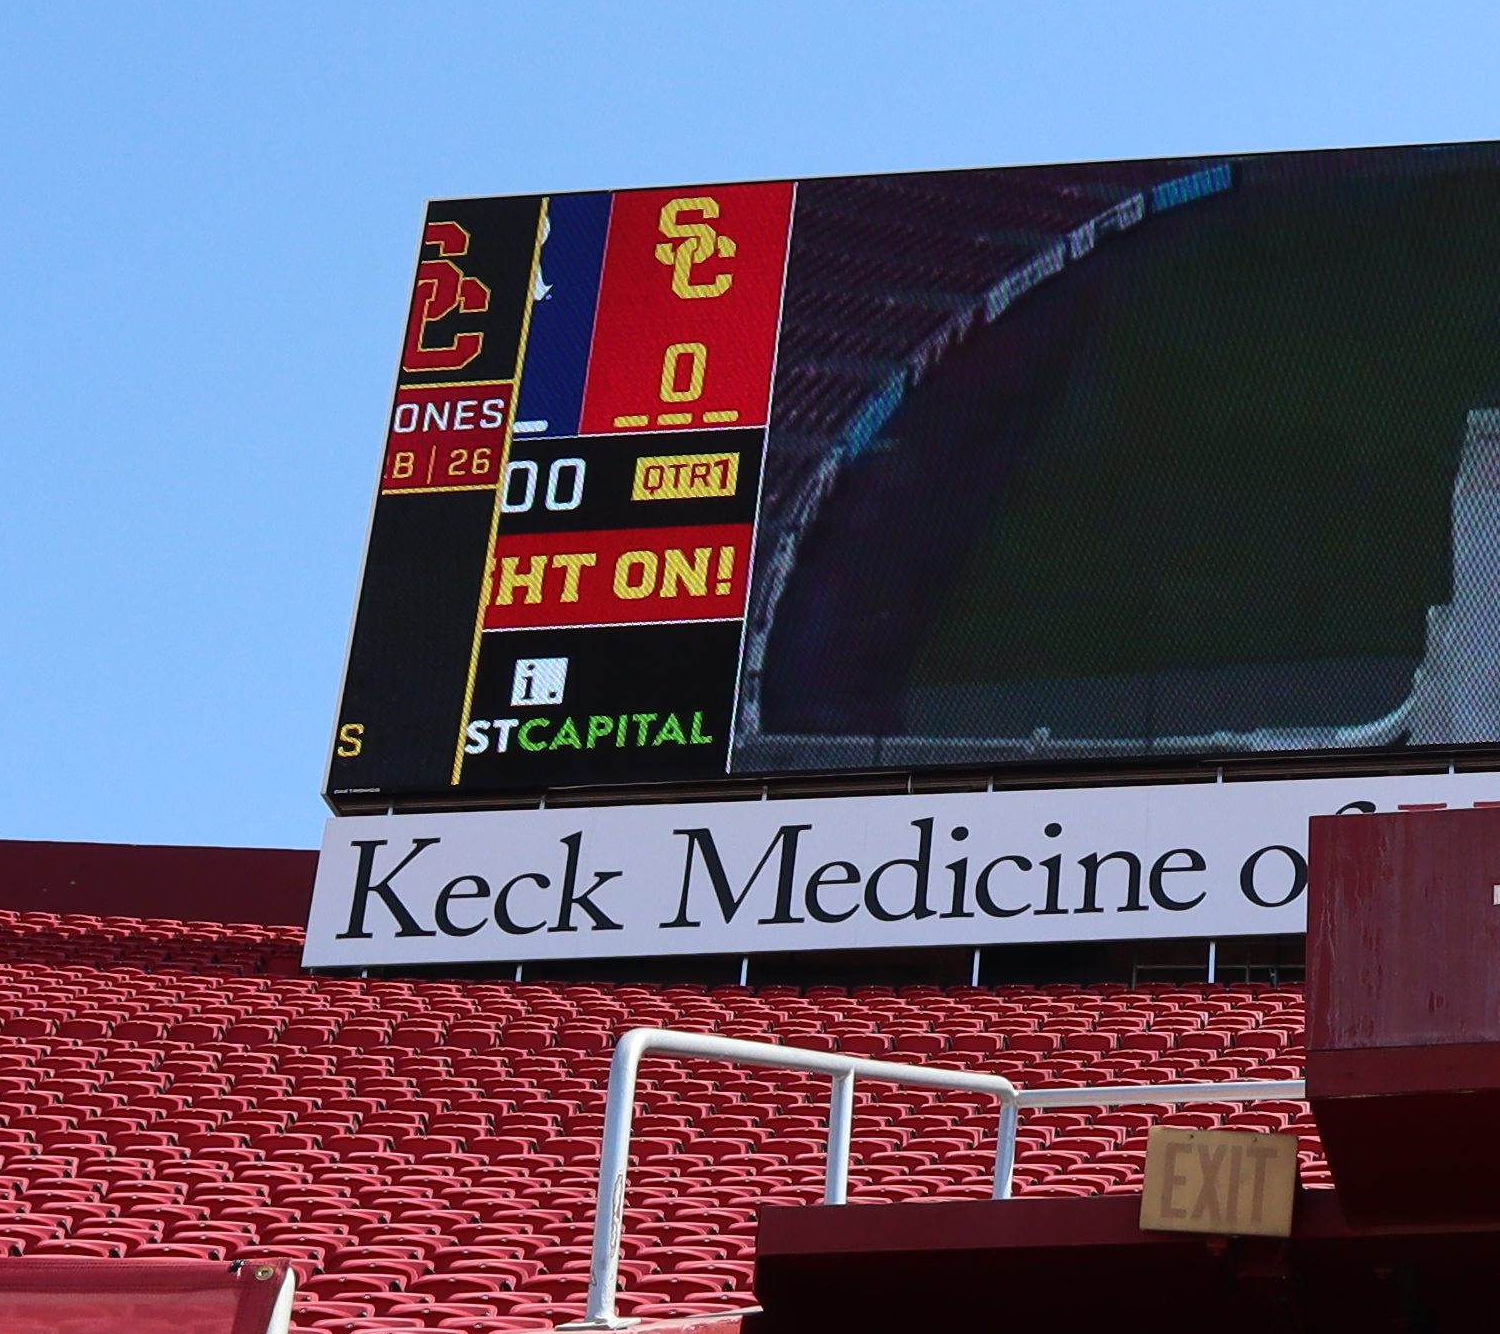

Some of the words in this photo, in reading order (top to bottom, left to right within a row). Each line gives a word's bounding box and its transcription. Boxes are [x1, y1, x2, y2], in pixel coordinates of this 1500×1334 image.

[660, 342, 707, 403] 0
[393, 398, 505, 433] ONES
[448, 447, 492, 476] 26
[643, 459, 730, 495] QTR1
[613, 546, 735, 599] ON!
[336, 723, 365, 758] S
[335, 830, 624, 942] Keck
[658, 816, 1209, 931] Medicine
[1159, 1142, 1279, 1227] EXIT
